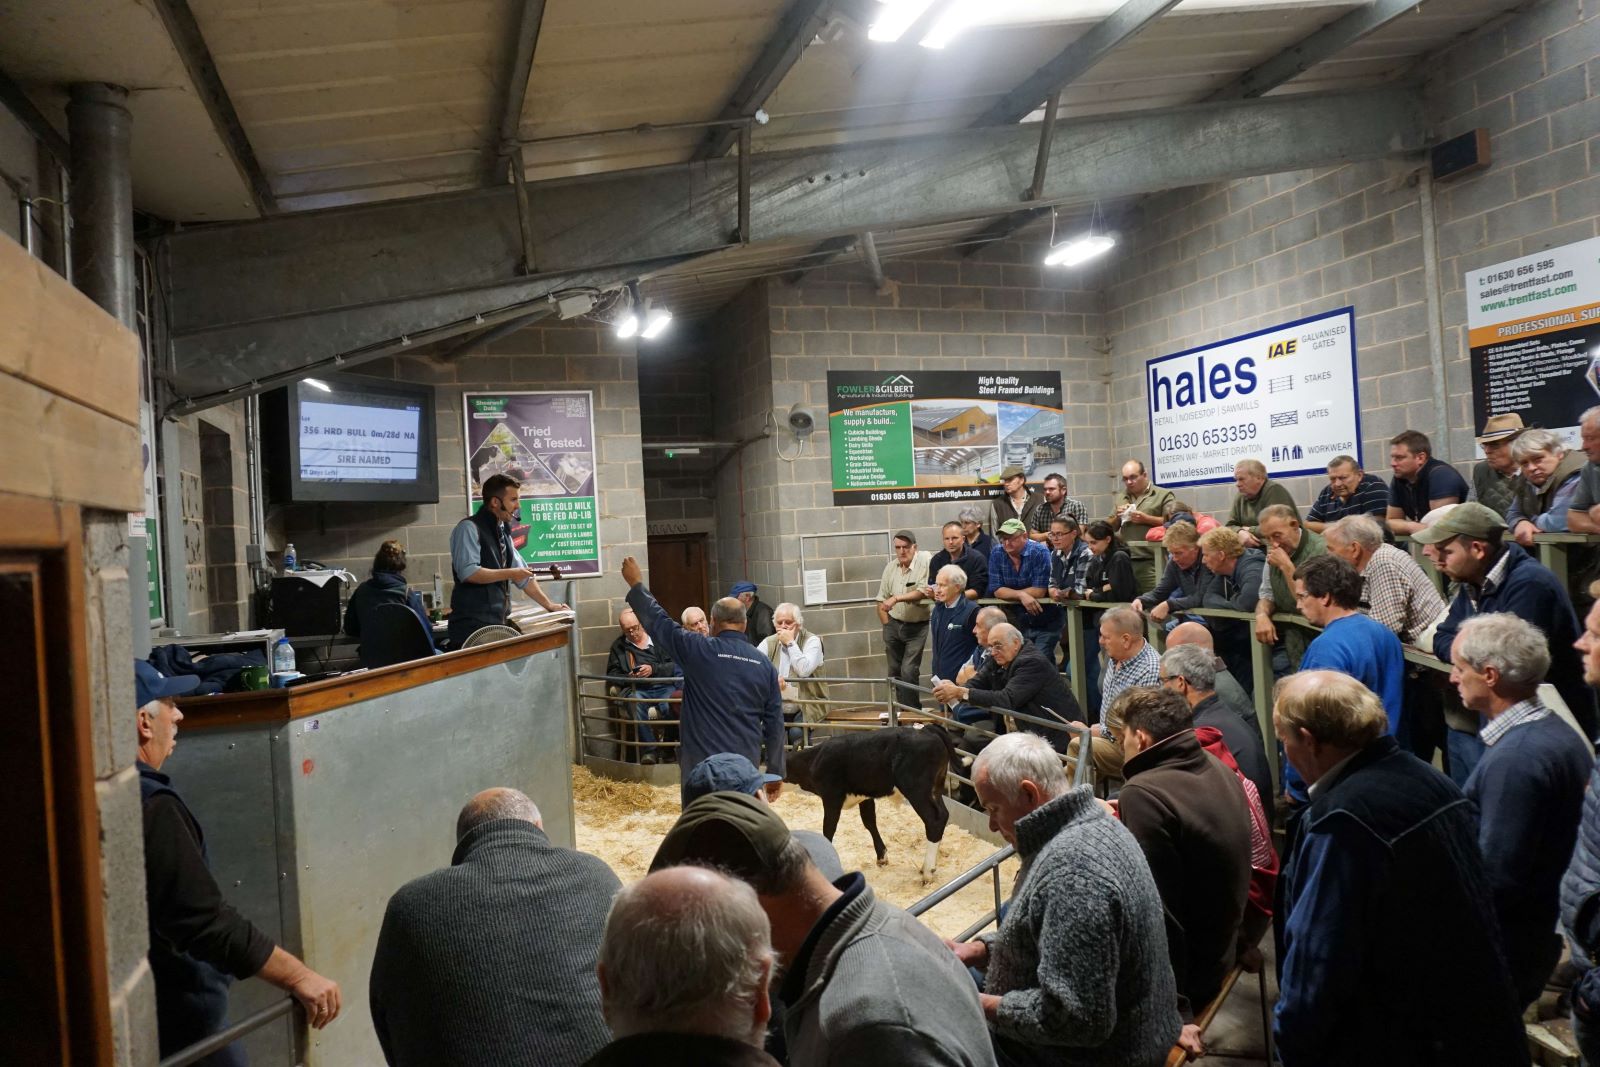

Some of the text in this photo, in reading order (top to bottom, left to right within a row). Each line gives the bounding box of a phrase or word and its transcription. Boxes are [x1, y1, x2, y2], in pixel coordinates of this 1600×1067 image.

[1487, 269, 1514, 284] 01630
[1517, 264, 1534, 276] 656
[1537, 258, 1554, 272] 595
[1480, 270, 1574, 299] sales@trentfast.com
[1481, 284, 1577, 312] www.trentfast.com
[1498, 312, 1578, 337] PROFESSIONAL
[1302, 326, 1346, 343] GALVANISED
[1268, 340, 1297, 358] IAE
[1312, 338, 1336, 350] GATES
[978, 376, 1019, 386] High Quality
[1304, 370, 1332, 384] STAKES
[1024, 386, 1055, 395] Buildings
[1152, 356, 1258, 412] hales
[855, 408, 898, 416] manufacture,
[1154, 416, 1175, 426] RETAIL
[1221, 400, 1260, 415] SAWMILLS
[1306, 408, 1330, 420] GATES
[304, 426, 319, 434] 356
[324, 427, 342, 435] HRD
[347, 428, 366, 437] BULL
[371, 430, 400, 439] 0m/28d
[521, 426, 551, 436] Tried
[1160, 422, 1257, 452] 01630 653359
[533, 437, 586, 448] & Tested.
[1307, 441, 1353, 454] WORKWEAR
[337, 455, 391, 465] SIRE NAMED
[1157, 453, 1185, 464] WESTERN
[1186, 452, 1199, 461] WAY
[1203, 448, 1229, 460] MARKET
[1231, 443, 1263, 456] DRAYTON
[531, 502, 591, 512] HEATS COLD MILK
[532, 511, 592, 521] TO BE FED AD-LIB
